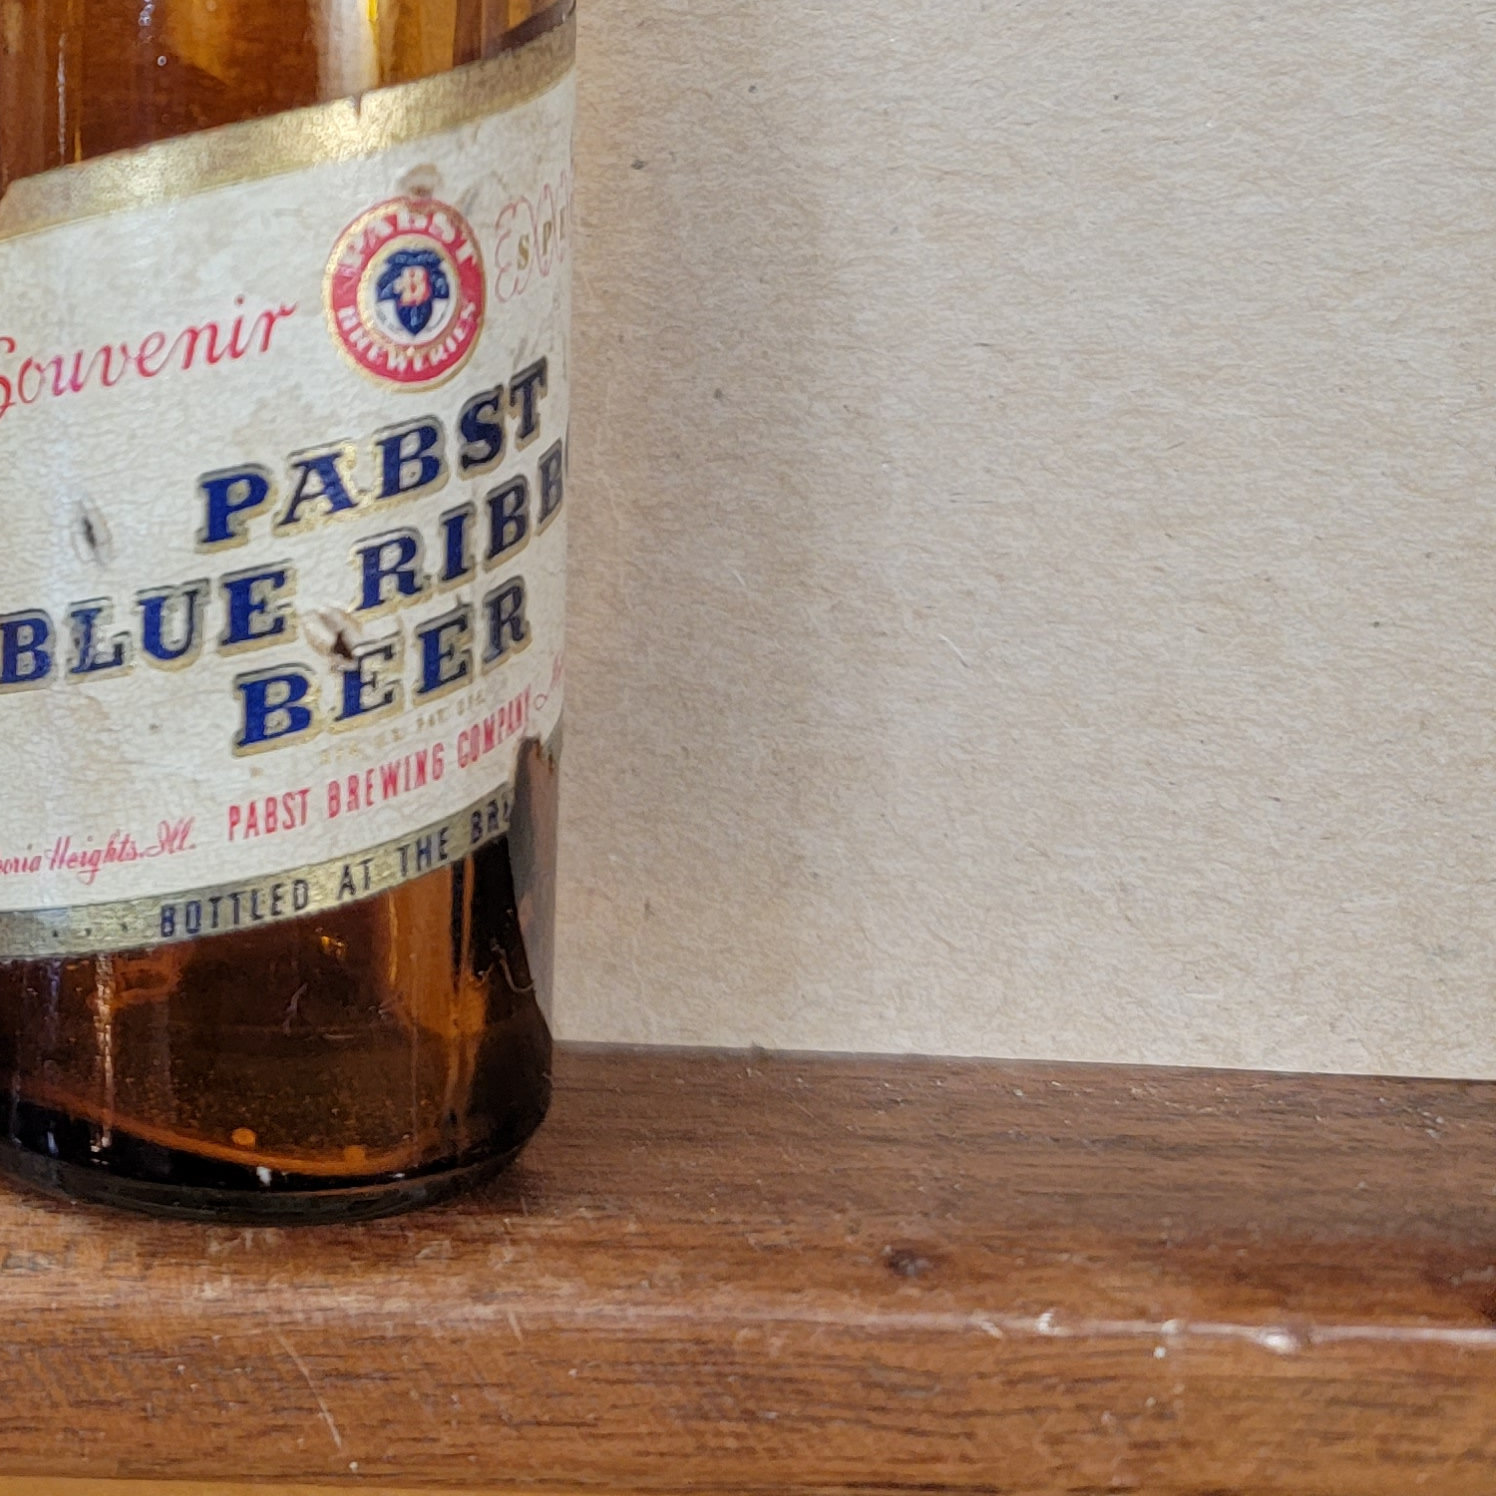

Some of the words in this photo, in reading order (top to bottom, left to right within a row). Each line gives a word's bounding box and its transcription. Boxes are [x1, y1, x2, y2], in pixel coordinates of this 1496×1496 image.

[200, 357, 551, 548] PABST
[237, 577, 530, 752] BEER
[227, 787, 312, 842] PABST
[327, 742, 445, 819] BREWING
[160, 878, 310, 938] BOTTLED
[336, 856, 373, 900] AT
[397, 825, 450, 877] THE
